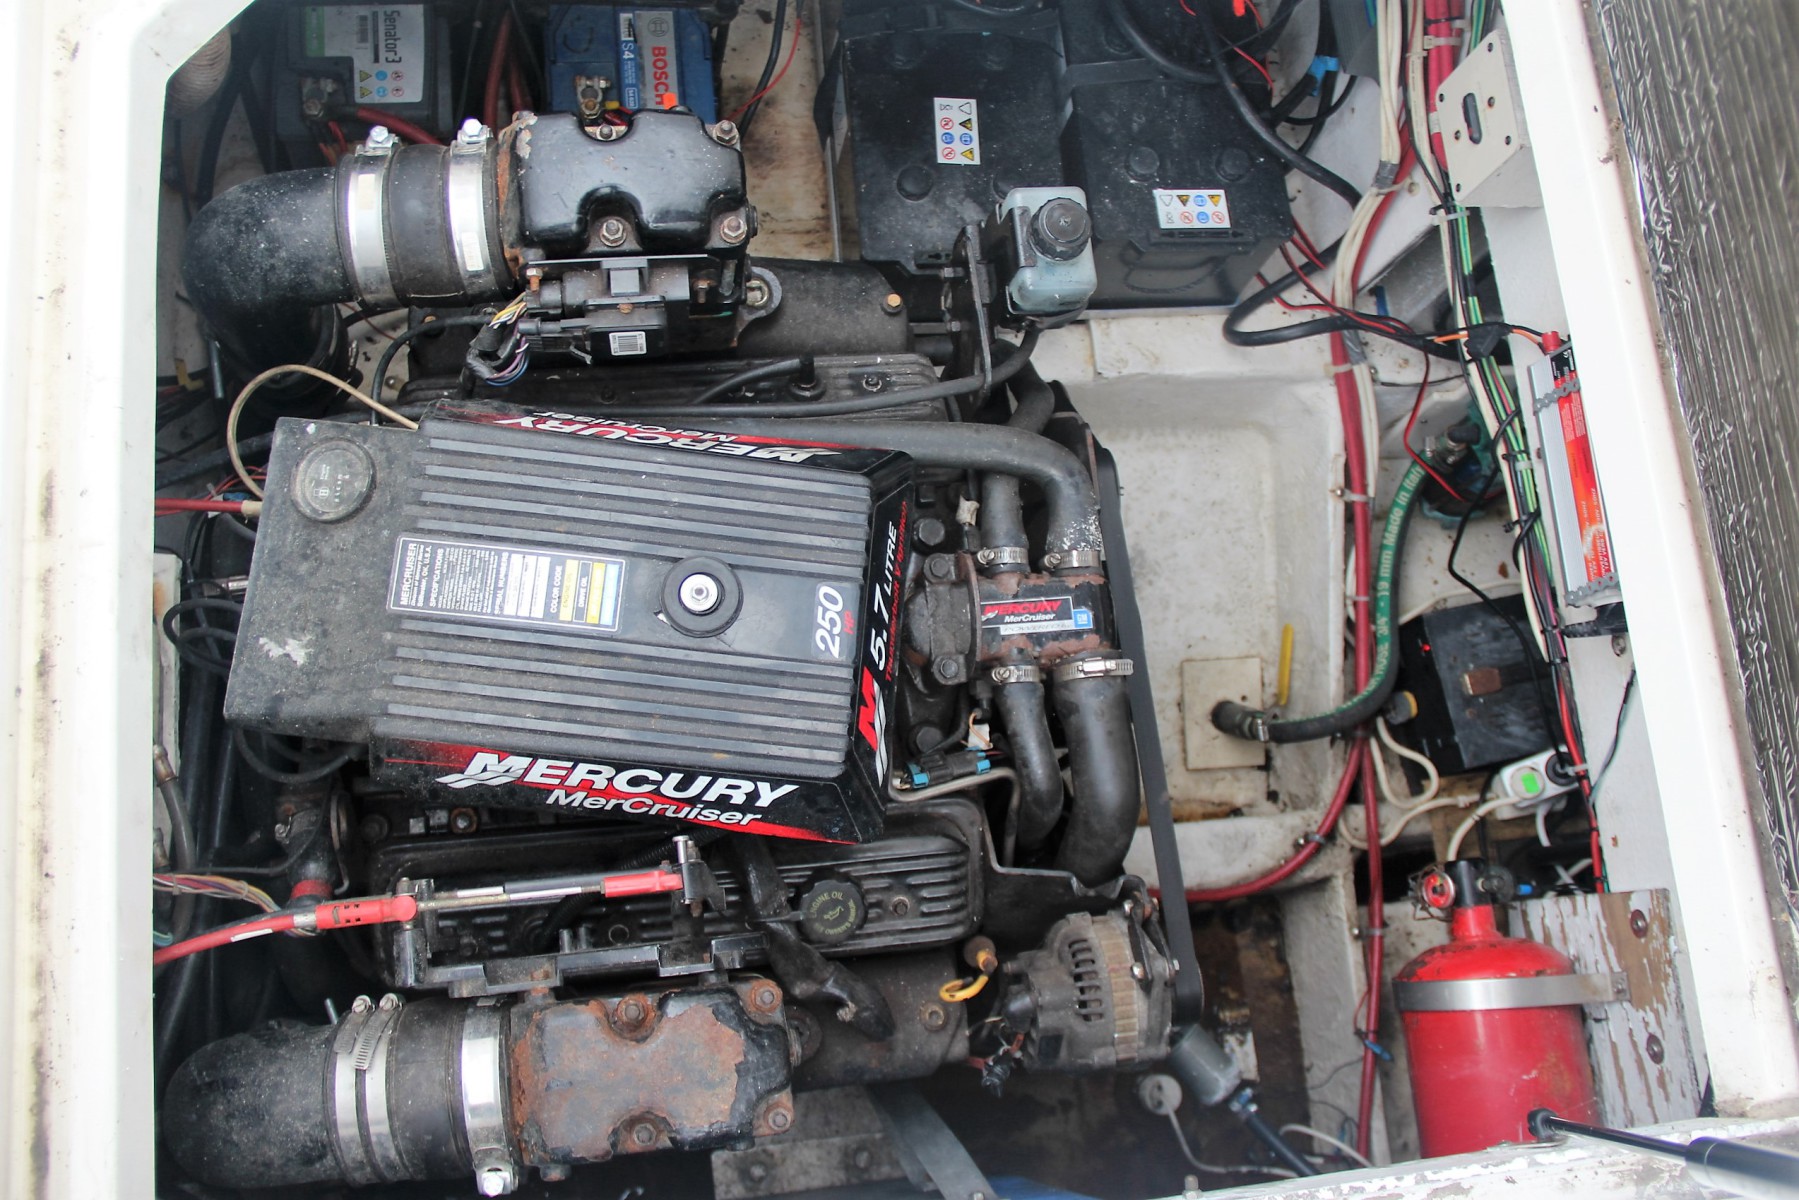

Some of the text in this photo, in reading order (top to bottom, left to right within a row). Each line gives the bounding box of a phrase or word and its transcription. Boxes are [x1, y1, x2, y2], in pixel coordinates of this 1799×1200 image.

[384, 10, 402, 64] Senator 3
[494, 415, 828, 463] MERCURY
[533, 411, 739, 442] MerCruiser
[1396, 492, 1410, 506] in
[1383, 509, 1404, 546] Made
[400, 543, 417, 606] MERCRUISER
[429, 548, 444, 608] SPECIFICATIONS
[498, 552, 509, 588] NUMBERS
[1380, 551, 1392, 577] mm
[550, 565, 563, 613] COLOR CODE
[562, 585, 571, 608] ENGINE
[578, 576, 588, 608] DRIVE OIL
[871, 521, 897, 671] 5.7 LITRE
[815, 585, 844, 659] 250
[844, 610, 856, 636] HP
[983, 600, 1062, 617] MERCURY
[1004, 613, 1056, 623] MerCruiser
[448, 751, 799, 808] MERCURY
[545, 789, 762, 826] MerCruiser
[831, 891, 843, 900] OIL
